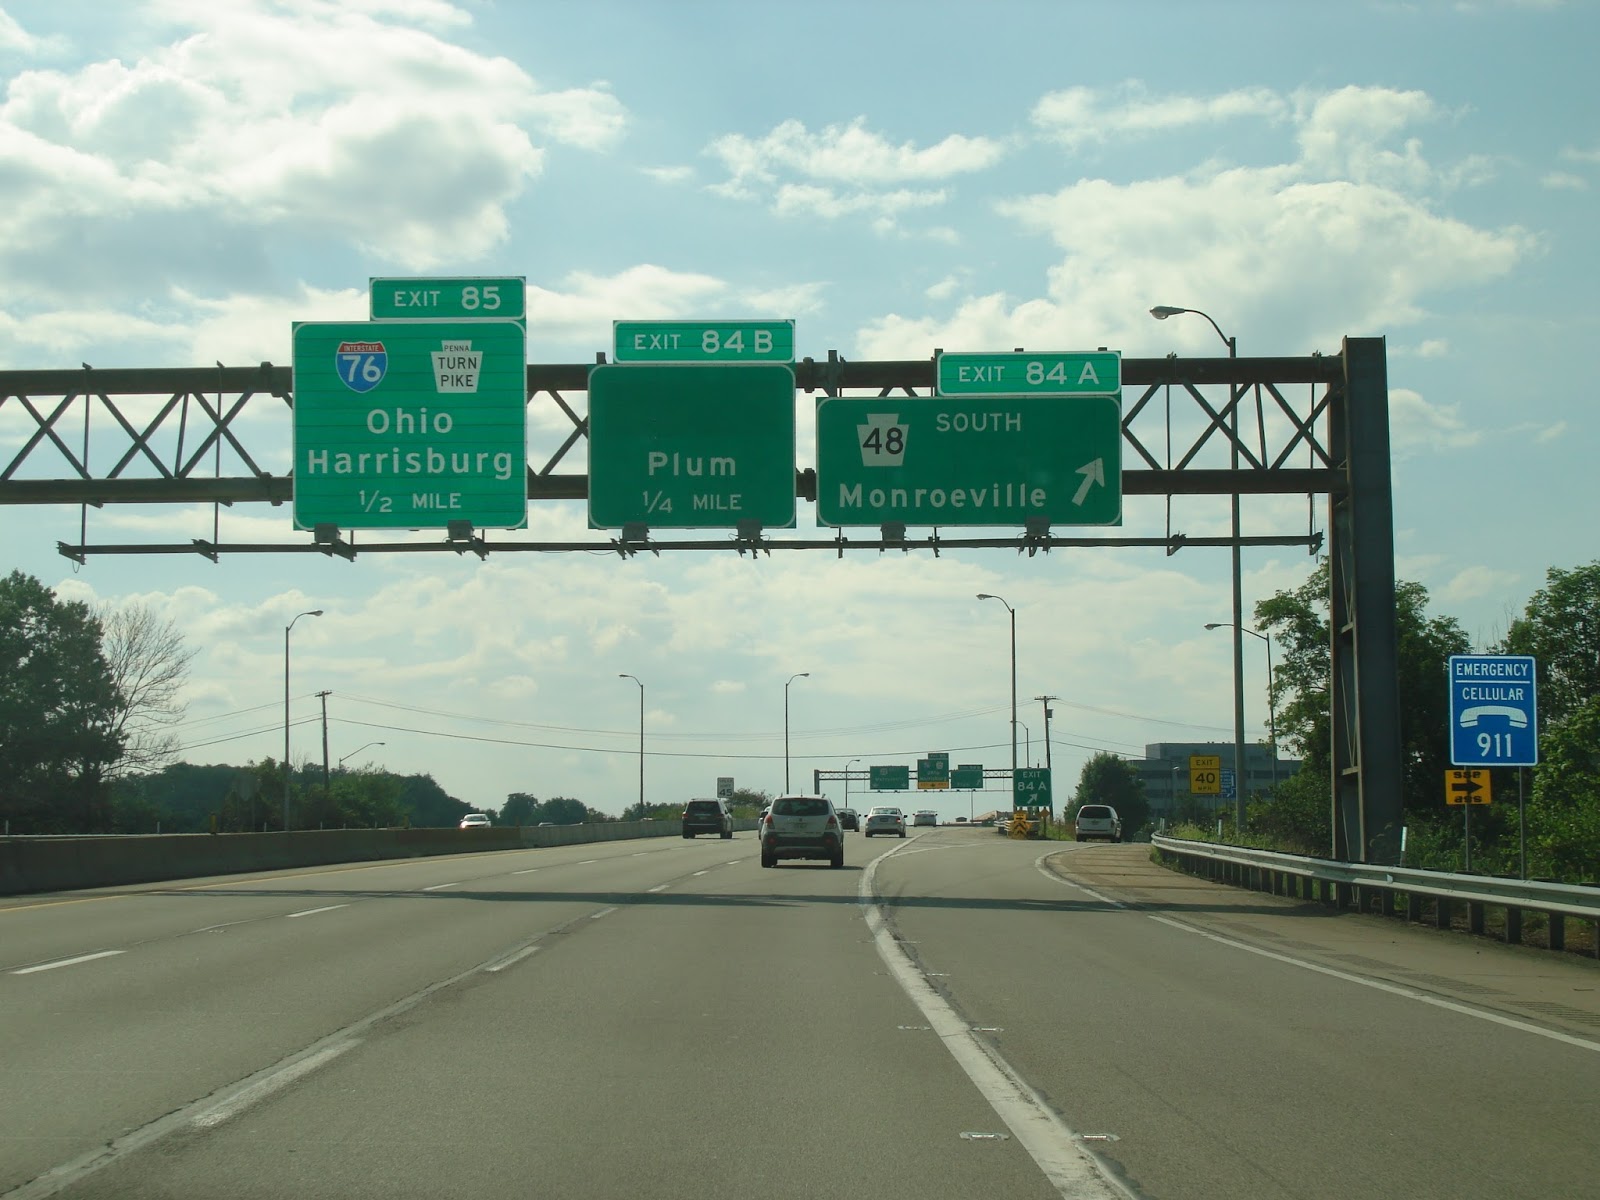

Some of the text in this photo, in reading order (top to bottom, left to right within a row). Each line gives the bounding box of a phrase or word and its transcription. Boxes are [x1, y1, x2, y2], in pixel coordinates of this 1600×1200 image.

[394, 286, 501, 310] EXIT 85
[343, 344, 379, 352] INTERSTATE
[444, 344, 470, 352] PENNA
[634, 330, 774, 354] EXIT 84 B
[342, 355, 381, 383] 76
[438, 357, 477, 370] TURN
[959, 361, 1100, 385] EXIT 84 A
[440, 374, 474, 387] PIKE
[366, 407, 453, 434] Ohio
[936, 412, 1022, 432] SOUTH
[862, 427, 904, 455] 48
[307, 447, 513, 481] Harrisburg
[648, 452, 737, 477] Plum
[359, 490, 462, 513] 1/2 MILE
[643, 490, 742, 514] 1/4 MILE
[839, 483, 1047, 509] Monroeville
[1456, 663, 1529, 677] EMERGENCY
[1462, 687, 1524, 701] CELLULAR
[1477, 733, 1512, 758] 911
[1018, 781, 1047, 791] 84 A
[1195, 773, 1216, 784] 40
[719, 788, 733, 797] 45
